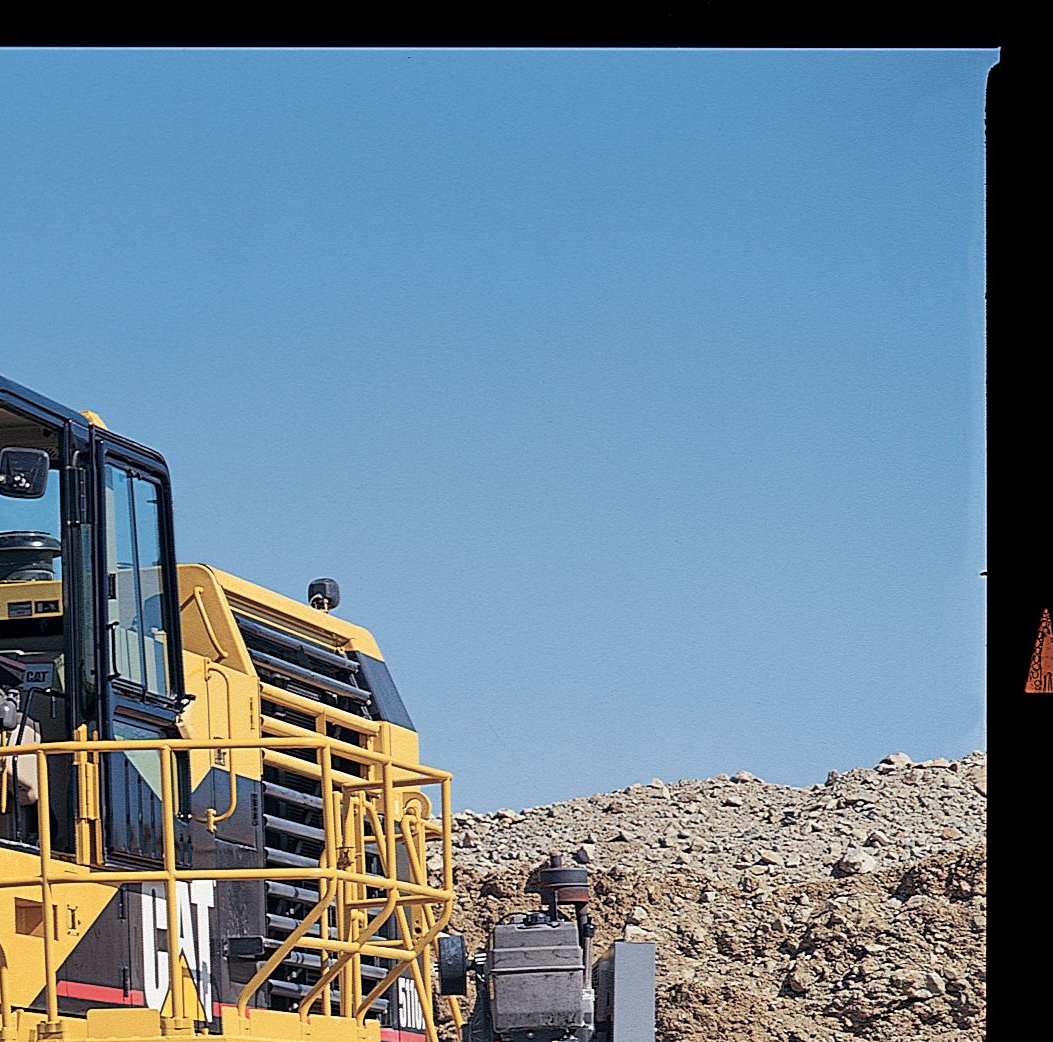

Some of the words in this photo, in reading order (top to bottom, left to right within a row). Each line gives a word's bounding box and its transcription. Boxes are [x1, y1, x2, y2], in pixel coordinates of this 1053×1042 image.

[27, 671, 49, 683] CAT
[141, 879, 216, 1023] CAT
[398, 977, 426, 1030] 5110
